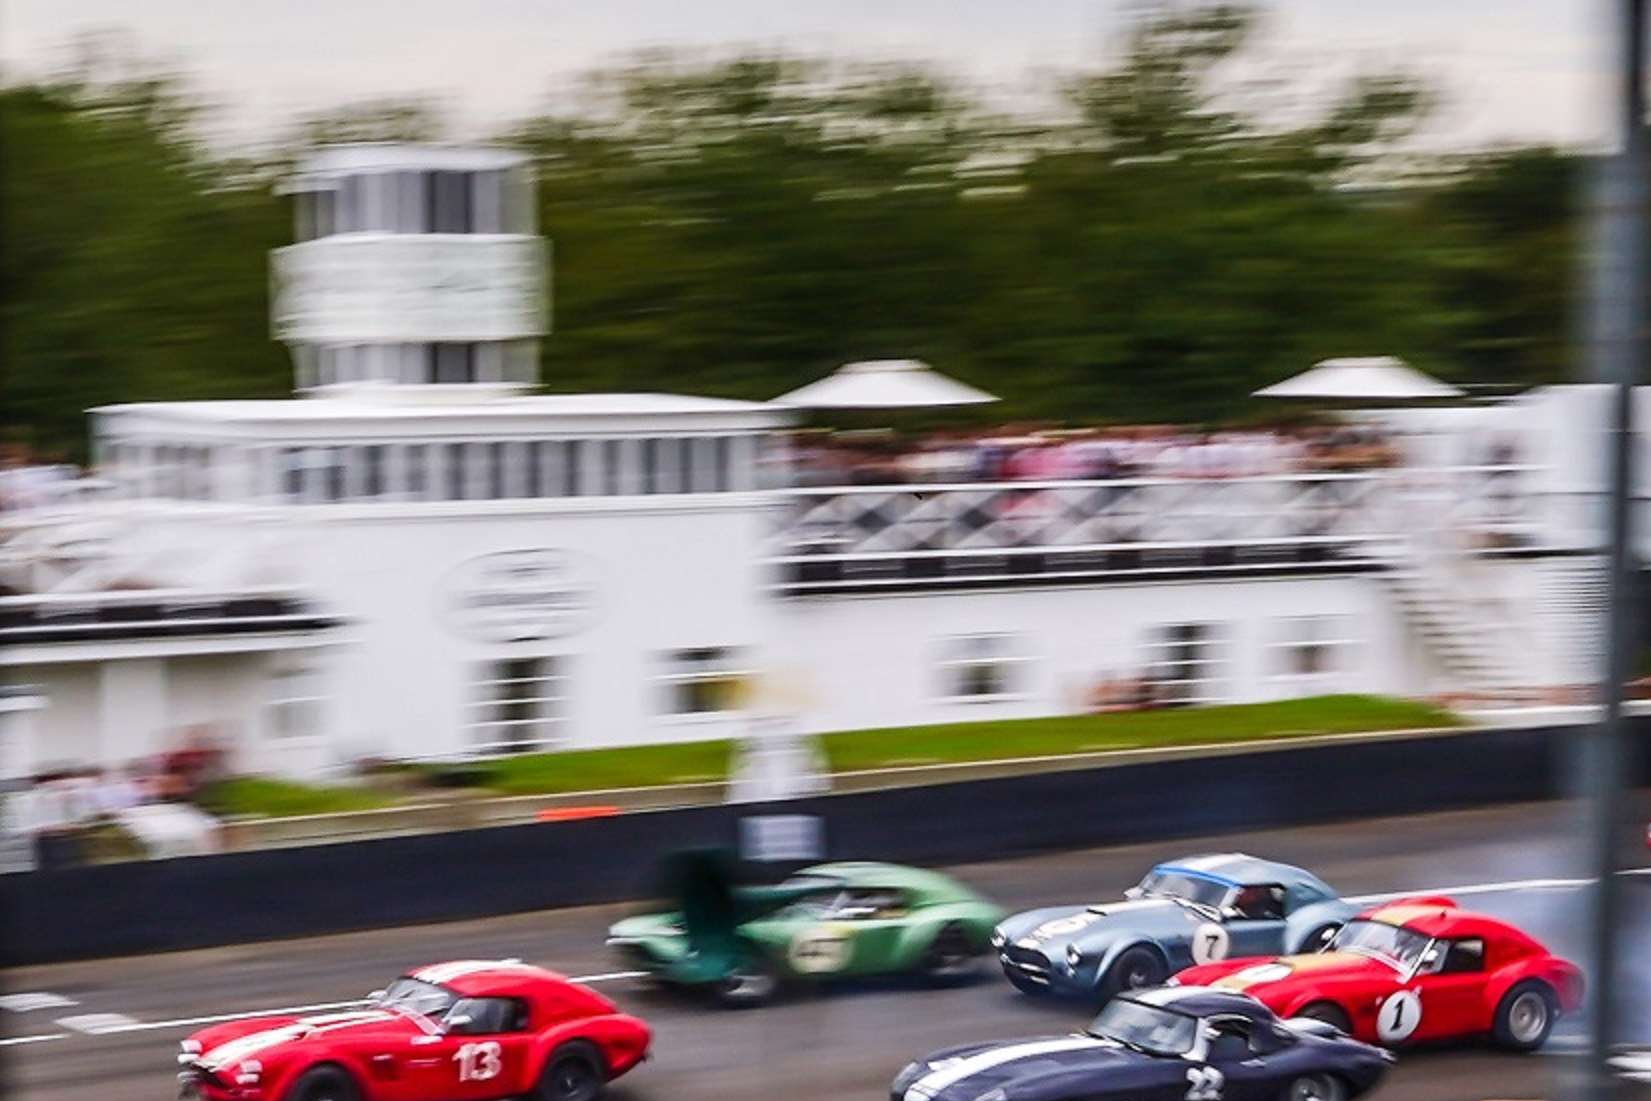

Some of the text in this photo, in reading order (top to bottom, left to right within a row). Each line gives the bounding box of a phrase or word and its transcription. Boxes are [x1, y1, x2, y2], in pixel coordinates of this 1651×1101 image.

[1205, 934, 1219, 960] 7
[1389, 997, 1405, 1032] 1
[451, 1041, 501, 1082] 13
